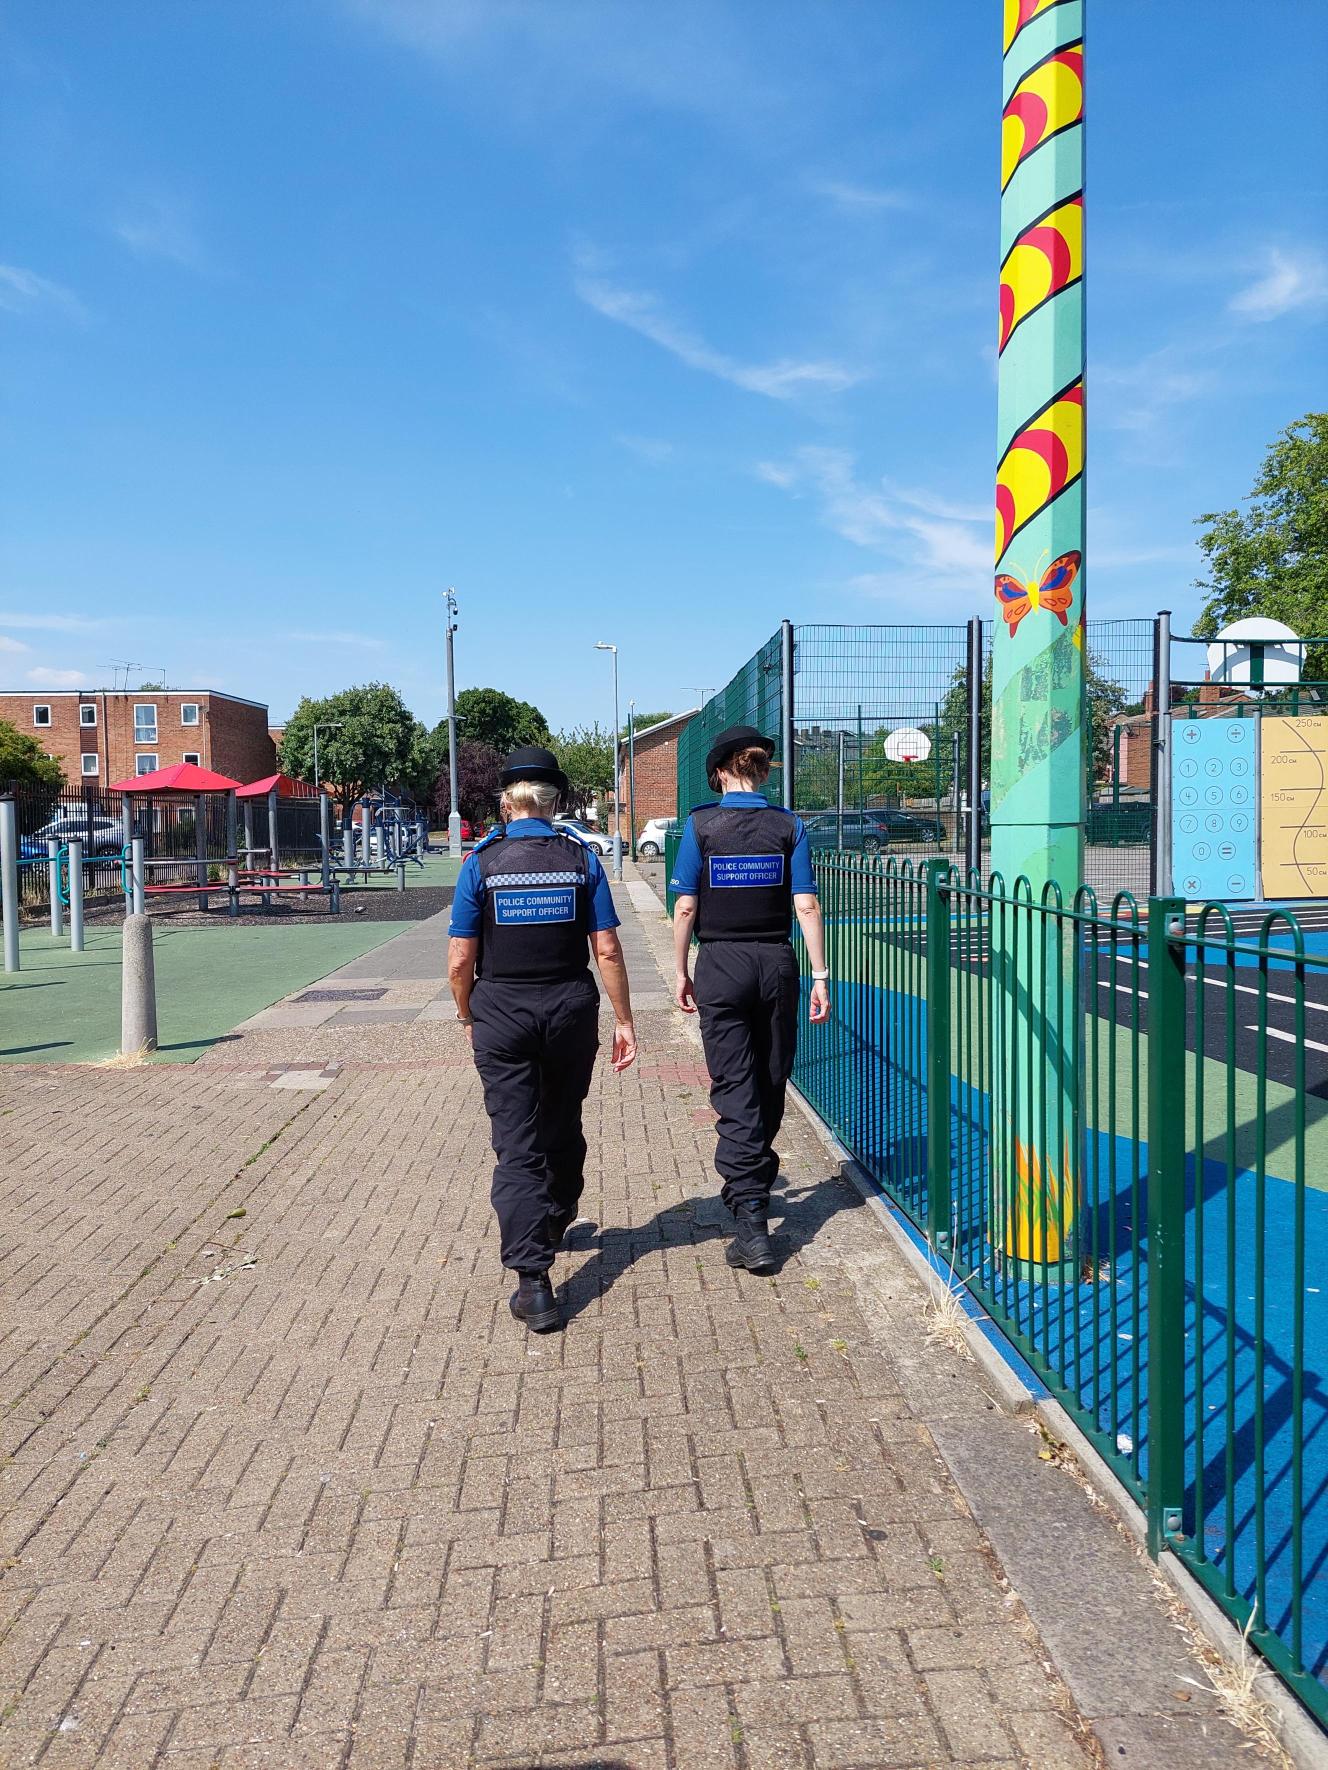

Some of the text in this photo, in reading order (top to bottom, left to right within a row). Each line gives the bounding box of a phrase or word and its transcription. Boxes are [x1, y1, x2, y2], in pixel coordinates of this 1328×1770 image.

[713, 862, 780, 870] POLICE COMMUNITY
[716, 872, 777, 880] SUPPORT OFFICER
[498, 896, 572, 906] POLICE COMMUNITY
[502, 906, 568, 917] SUPPORT OFFICER
